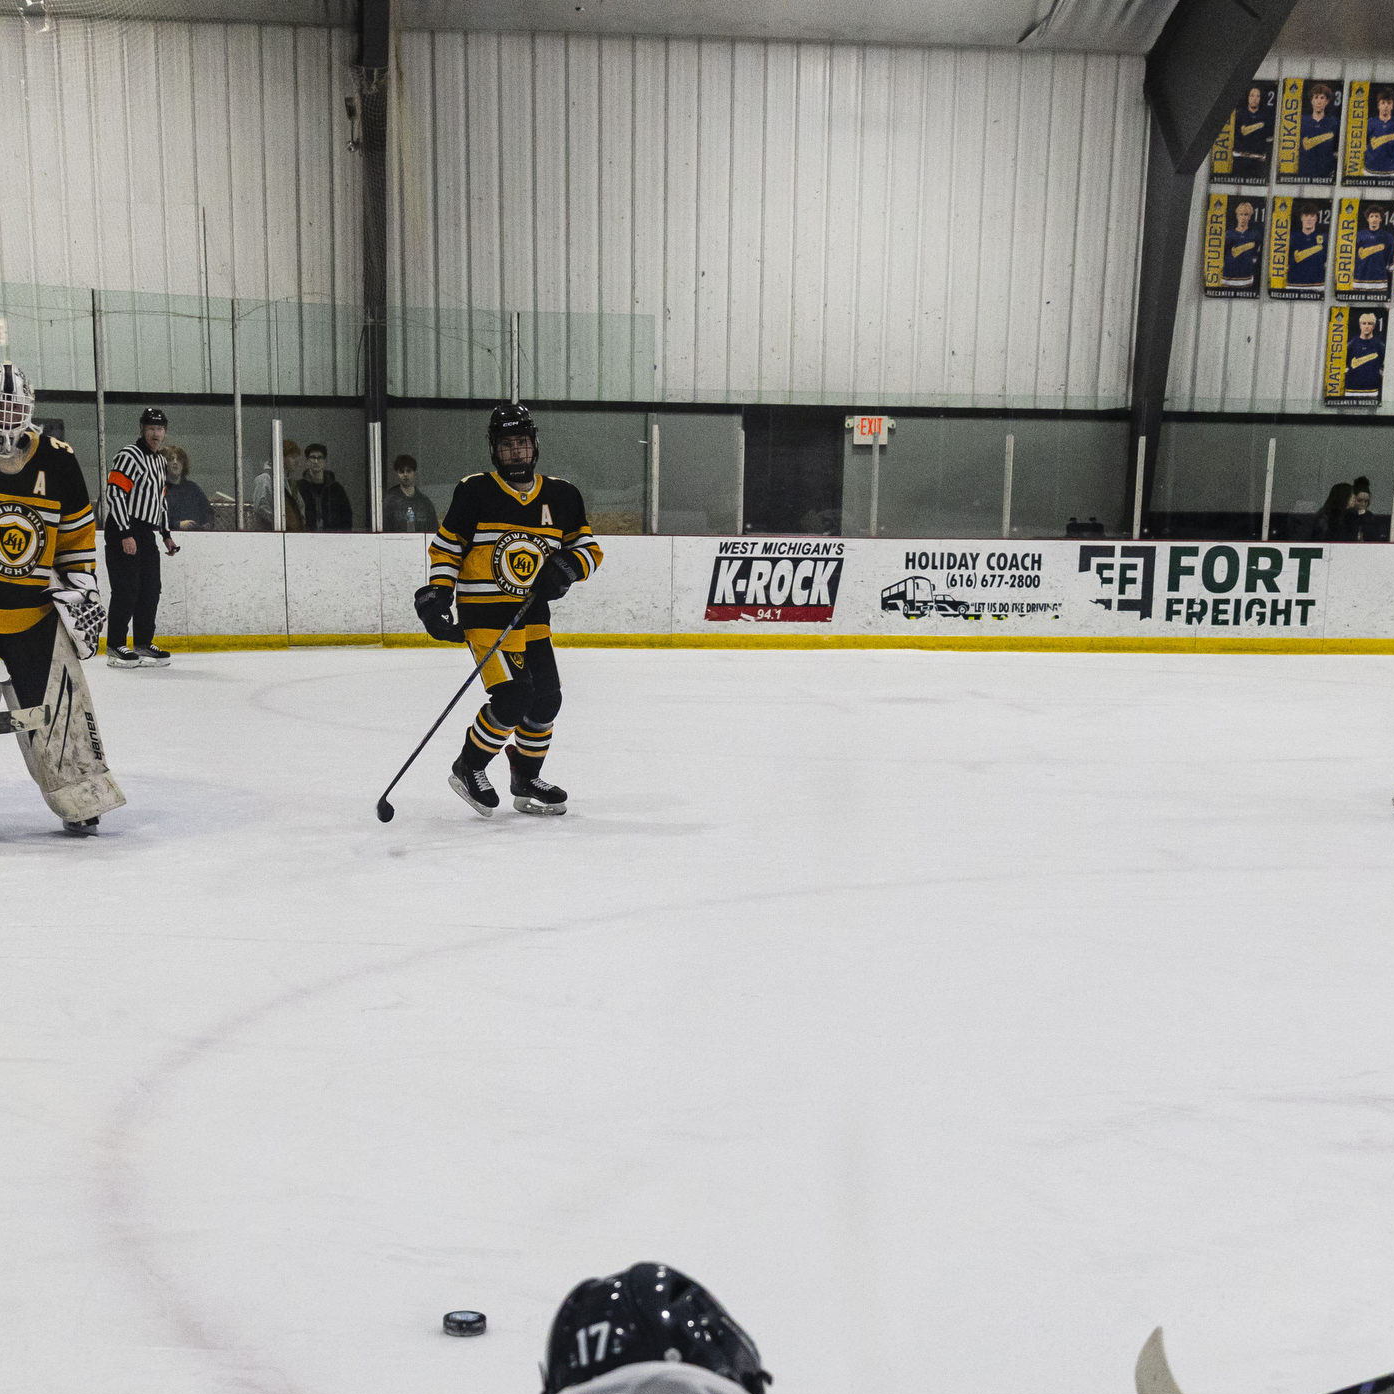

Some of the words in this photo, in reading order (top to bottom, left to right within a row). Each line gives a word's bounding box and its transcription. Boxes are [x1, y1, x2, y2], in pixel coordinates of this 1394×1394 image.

[1267, 91, 1274, 106] 2
[1334, 91, 1342, 106] 3
[1281, 98, 1299, 164] LUKAS
[1347, 100, 1365, 175] WHEELER
[1253, 208, 1265, 222] 11
[1318, 210, 1331, 224] 12
[1207, 213, 1223, 284] STUDER
[1272, 218, 1288, 278] HENKE
[1338, 219, 1355, 284] GRIBAR
[1378, 318, 1383, 332] 1
[1328, 324, 1344, 394] MATTSON
[860, 418, 883, 435] EXIT
[33, 470, 46, 496] A
[541, 504, 553, 526] A
[494, 533, 529, 564] KENOWA
[533, 536, 550, 558] HILL
[719, 541, 758, 555] WEST
[761, 542, 845, 556] MICHIGAN'S
[905, 552, 981, 571] HOLIDAY
[986, 553, 1042, 572] COACH
[1167, 545, 1323, 594] FORT
[497, 576, 530, 595] KNIGH
[713, 559, 839, 606] K-ROCK
[945, 573, 978, 589] (616)
[980, 574, 1041, 589] 677-2800
[756, 608, 781, 620] 94.1
[999, 602, 1009, 613] DO
[1165, 598, 1316, 626] FREIGHT
[85, 711, 103, 761] BAUER
[576, 1321, 611, 1368] 17
